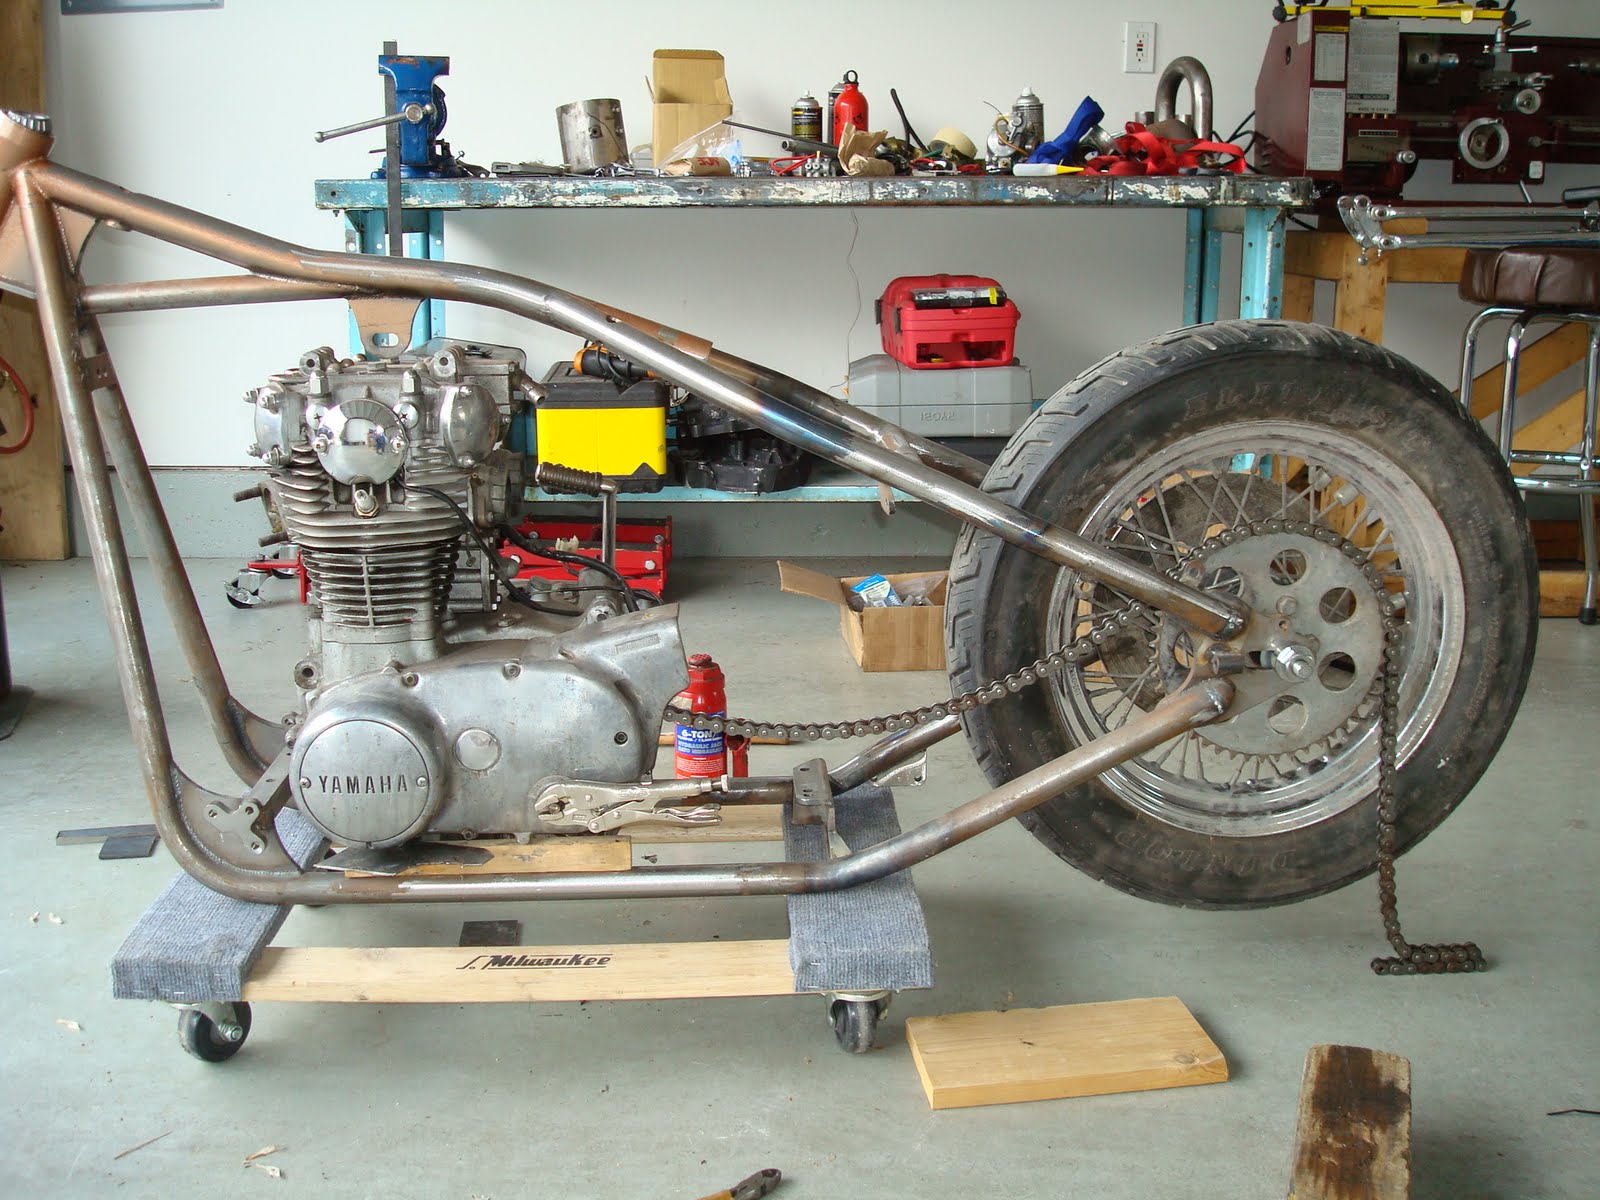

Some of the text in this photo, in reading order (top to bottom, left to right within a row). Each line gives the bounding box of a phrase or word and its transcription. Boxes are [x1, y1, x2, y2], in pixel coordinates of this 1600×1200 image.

[920, 411, 956, 423] RYOBI
[318, 774, 409, 795] YAMAHA
[487, 953, 612, 969] Milwaukee
